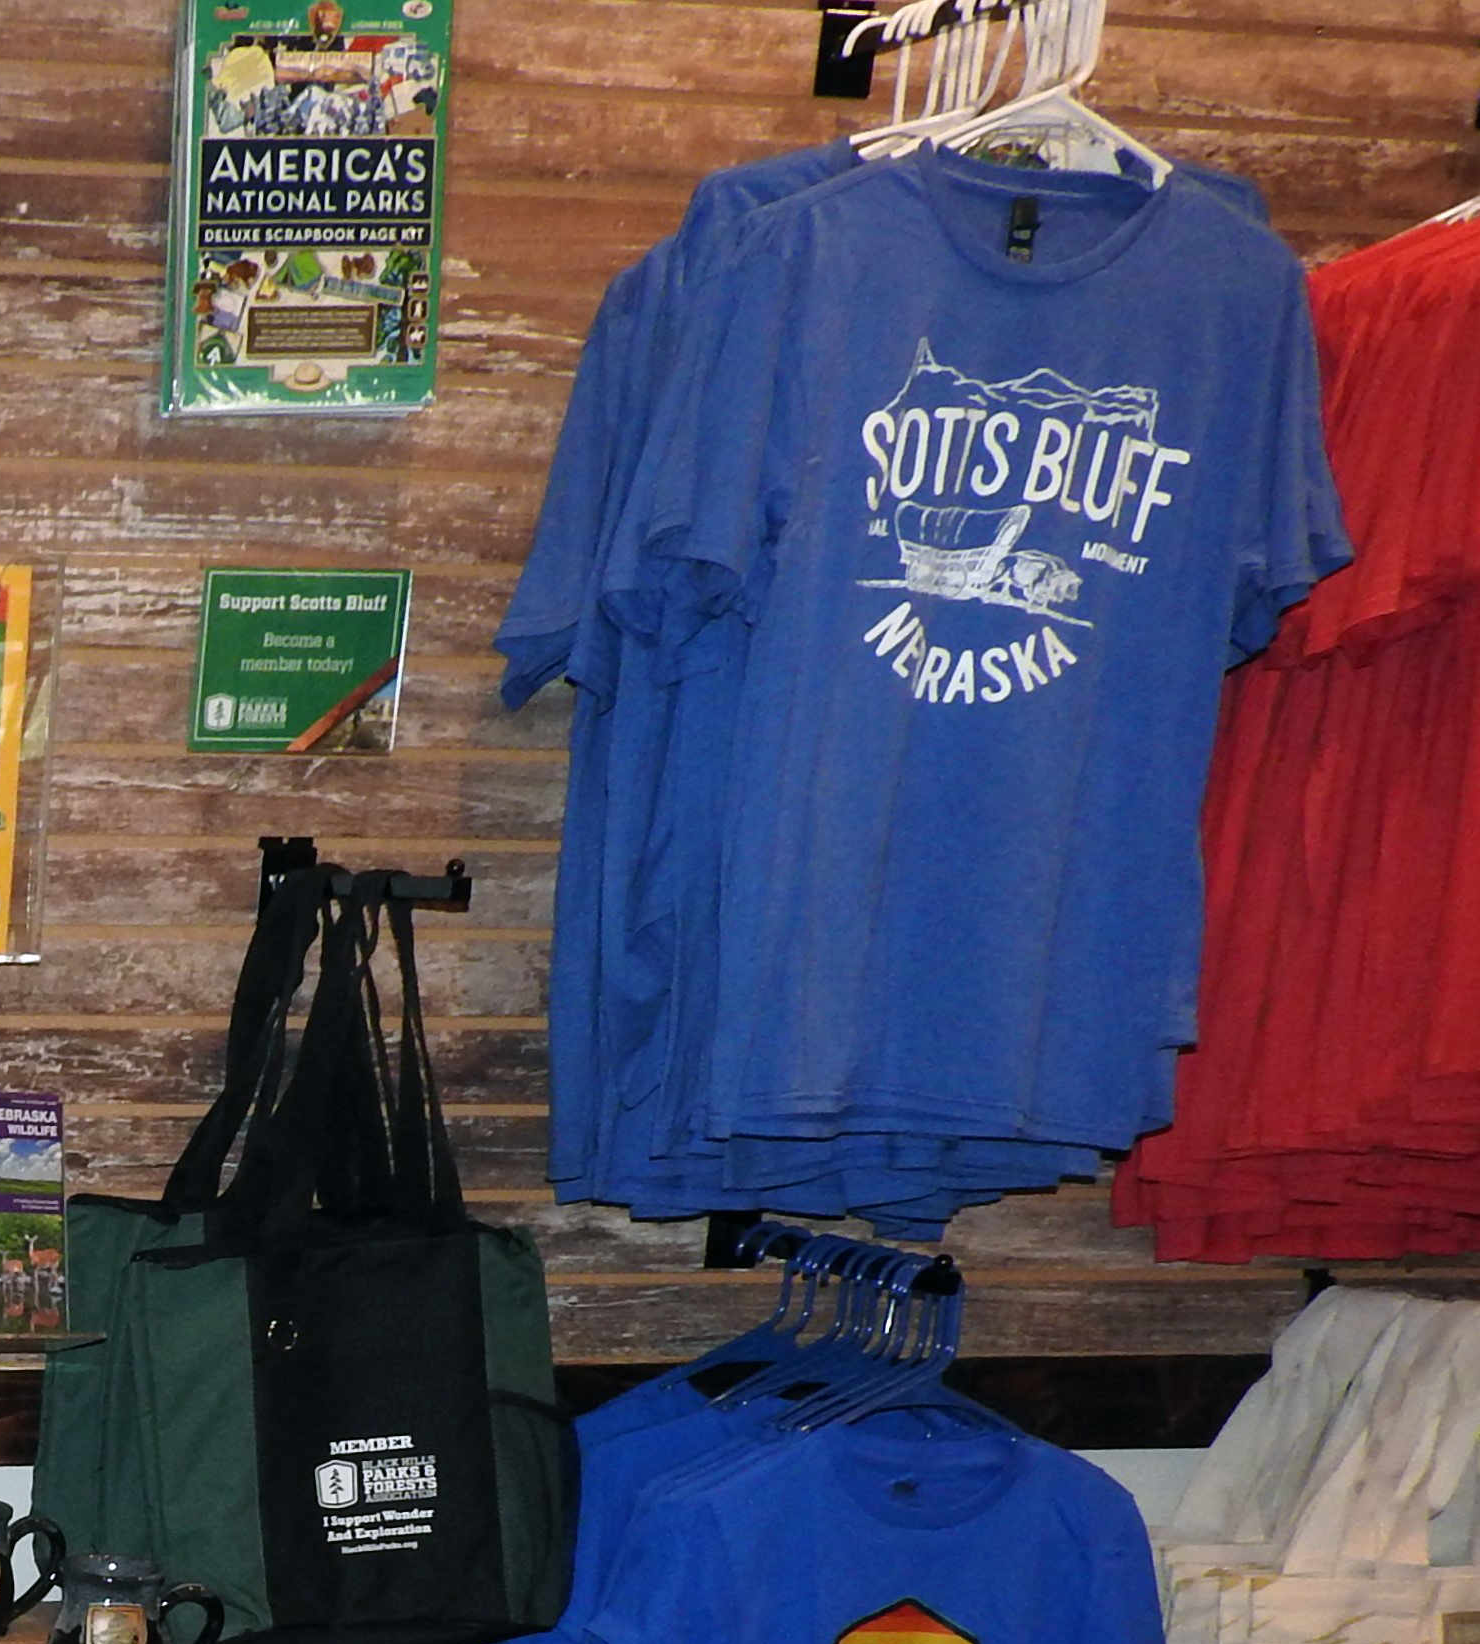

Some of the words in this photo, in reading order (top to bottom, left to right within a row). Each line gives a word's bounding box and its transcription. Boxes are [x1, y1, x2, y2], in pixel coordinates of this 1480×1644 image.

[208, 143, 427, 184] AMERICA'S
[206, 189, 338, 214] NATIONAL
[345, 190, 426, 215] PARKS
[204, 227, 261, 244] DELUXE
[264, 227, 355, 243] SCRAPBOOK
[359, 227, 398, 242] PAGE
[1022, 417, 1191, 544] BLUFF
[218, 593, 286, 613] Support
[289, 593, 343, 612] Scotts
[345, 594, 389, 612] Bluff
[263, 631, 323, 648] Become
[325, 635, 336, 648] a
[240, 656, 303, 673] member
[307, 656, 355, 675] today!
[7, 1123, 59, 1138] WILDLIFE
[329, 1435, 415, 1456] MEMBER
[361, 1457, 400, 1471] BLACK
[400, 1454, 437, 1468] HILLS
[362, 1465, 422, 1483] PARKS
[423, 1463, 437, 1478] &
[363, 1476, 439, 1495] FORESTS
[322, 1515, 329, 1527] I
[330, 1511, 382, 1528] Support
[381, 1507, 435, 1522] Wonder
[326, 1530, 353, 1543] And
[354, 1522, 433, 1541] Exploration
